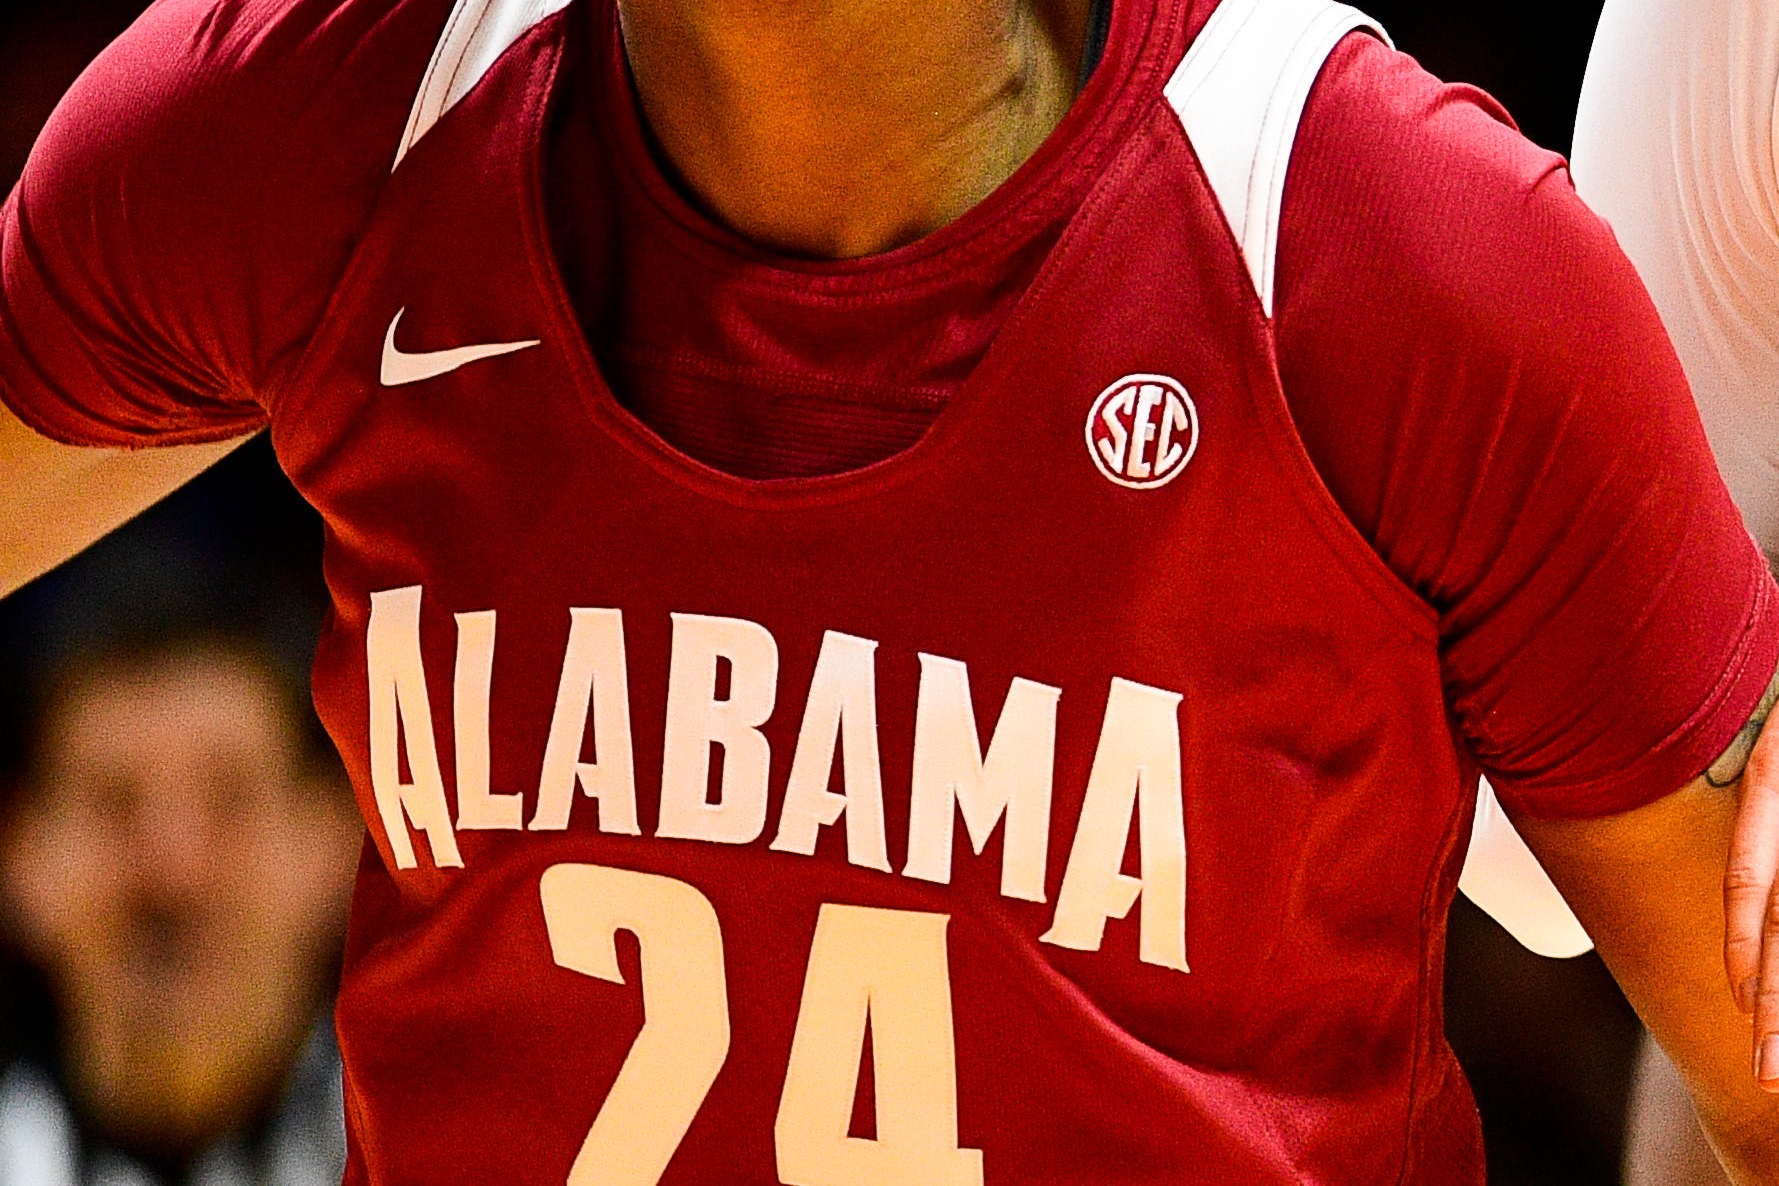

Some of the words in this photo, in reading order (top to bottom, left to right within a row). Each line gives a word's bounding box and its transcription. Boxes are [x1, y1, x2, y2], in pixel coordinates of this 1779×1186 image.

[1097, 384, 1189, 478] SEC
[366, 584, 1191, 974] ALABAMA
[538, 861, 985, 1186] 24
